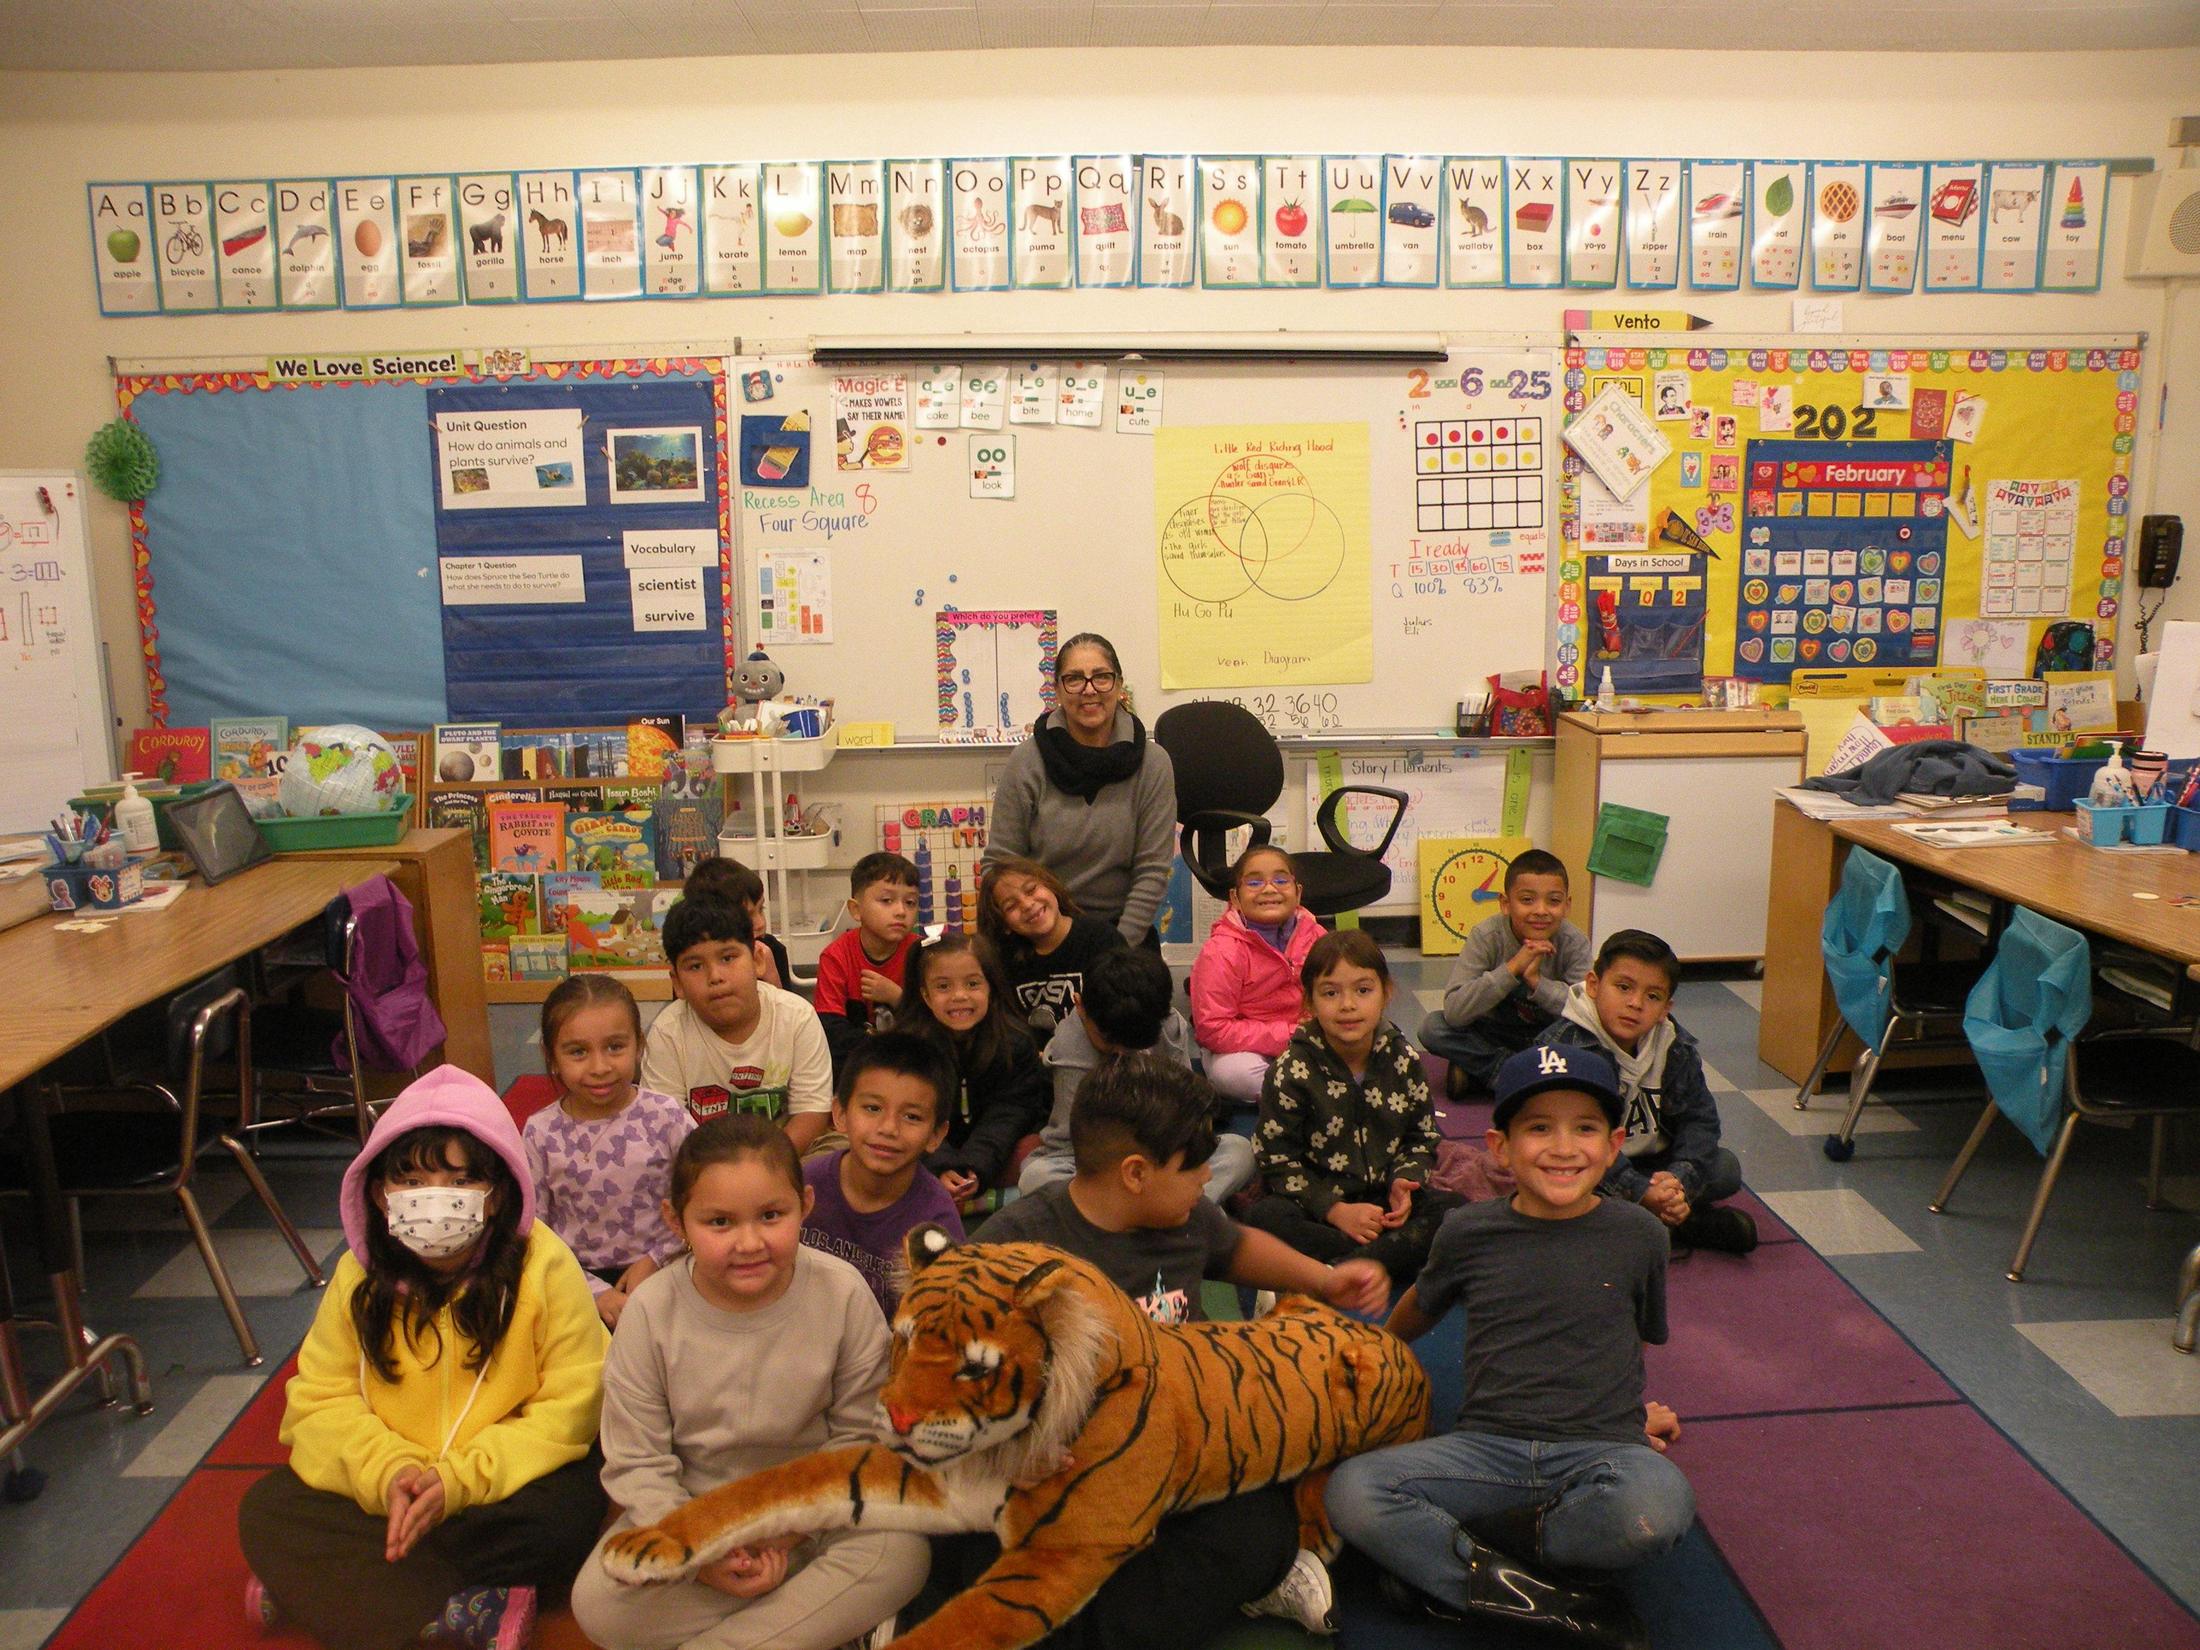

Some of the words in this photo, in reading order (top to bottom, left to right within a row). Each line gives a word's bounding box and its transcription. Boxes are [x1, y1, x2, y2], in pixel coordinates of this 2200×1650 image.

[1833, 231, 1847, 241] pie
[1886, 233, 1906, 242] boat
[1941, 234, 1965, 242] menu
[2002, 235, 2021, 243] cow
[2065, 234, 2080, 243] toy
[908, 246, 927, 255] nest
[963, 245, 1000, 255] octopus
[1029, 242, 1056, 253] puma
[1153, 241, 1182, 251] rabbit
[1223, 242, 1240, 251] sun
[1275, 241, 1307, 250] tomato
[1334, 240, 1375, 251] umbrella
[1402, 241, 1419, 250] van
[1458, 241, 1494, 253] wallaby
[1526, 241, 1544, 252] box
[1584, 242, 1606, 253] yo-yo
[1641, 241, 1668, 253] zipper
[658, 252, 684, 263] jump
[718, 250, 749, 260] karate
[778, 247, 807, 257] lemon
[846, 248, 867, 258] map
[476, 257, 505, 268] gorilla
[540, 255, 564, 264] horse
[601, 254, 622, 264] inch
[171, 267, 206, 278] bicycle
[232, 265, 262, 275] canoe
[361, 263, 380, 274] egg
[113, 269, 142, 280] apple
[1614, 314, 1660, 329] Vento
[276, 359, 307, 377] We
[313, 358, 363, 376] Love
[373, 354, 457, 375] Science!
[838, 378, 889, 395] Magic
[895, 377, 905, 391] E
[969, 378, 998, 394] ee
[849, 399, 872, 408] MAKES
[874, 397, 902, 407] VOWELS
[1022, 405, 1040, 415] bite
[1066, 408, 1093, 418] home
[847, 412, 859, 421] SAY
[862, 411, 882, 421] THEIR
[883, 411, 905, 421] NAME!
[926, 411, 949, 421] cake
[971, 411, 990, 421] bee
[1129, 417, 1150, 426] cute
[446, 420, 471, 432] Unit
[473, 419, 527, 432] Question
[448, 441, 474, 452] How
[477, 440, 493, 451] do
[495, 438, 541, 451] animals
[544, 437, 567, 449] and
[1246, 441, 1262, 453] Red
[1270, 441, 1302, 457] Riding
[977, 448, 1006, 463] oo
[449, 456, 486, 469] plants
[488, 454, 535, 466] survive?
[1825, 464, 1906, 489] February
[982, 480, 1002, 490] look
[744, 491, 800, 509] Recess
[810, 486, 845, 508] Area
[855, 484, 877, 514] 8
[760, 513, 797, 533] Four
[802, 510, 869, 540] Square
[1520, 531, 1546, 545] equals
[631, 543, 696, 556] Vocabulary
[1426, 536, 1470, 559] ready
[446, 561, 475, 570] Chapter
[483, 561, 517, 570] Question
[1615, 558, 1637, 568] Days
[1640, 557, 1649, 567] in
[1652, 557, 1684, 567] School
[1390, 564, 1400, 578] T
[1411, 565, 1423, 573] 15
[1430, 564, 1448, 573] 30
[1472, 562, 1487, 571] 60
[1496, 562, 1509, 570] 75
[509, 572, 521, 580] the
[522, 572, 536, 580] Sea
[538, 572, 559, 580] Turtle
[447, 583, 465, 591] what
[481, 582, 502, 590] needs
[533, 581, 561, 589] survive?
[638, 578, 697, 592] scientist
[1414, 577, 1447, 595] 100%
[1463, 575, 1503, 595] 83%
[1675, 591, 1685, 601] 2
[645, 610, 695, 622] survive
[953, 612, 978, 621] Which
[980, 612, 991, 620] do
[993, 612, 1009, 621] you
[1010, 610, 1040, 620] prefer?
[1988, 683, 2012, 694] FIRST
[2014, 683, 2043, 694] GRADE
[1990, 695, 2009, 704] HERE
[641, 717, 655, 726] Our
[656, 717, 670, 725] Sun
[220, 726, 270, 739] CORDUROY
[845, 727, 874, 746] word
[2027, 732, 2057, 745] STAND
[139, 735, 206, 754] CORDUROY
[1352, 760, 1388, 782] Story
[1393, 759, 1452, 774] Elements
[433, 794, 448, 804] The
[447, 792, 478, 803] Princess
[489, 791, 537, 803] Cinderella
[607, 788, 630, 798] Issun
[631, 787, 657, 798] Boshi
[903, 806, 985, 828] GRAPH
[499, 820, 537, 832] RABBIT
[513, 828, 551, 838] COYOTE
[953, 828, 986, 848] IT!
[1454, 861, 1466, 869] 11
[1471, 855, 1484, 864] 12
[493, 877, 507, 887] The
[1443, 875, 1456, 884] 10
[484, 882, 534, 894] Gingerbread
[491, 895, 508, 905] Man
[1438, 892, 1445, 900] 9
[1537, 1045, 1568, 1075] LA
[704, 1103, 728, 1114] TNT
[800, 1226, 829, 1248] LOS
